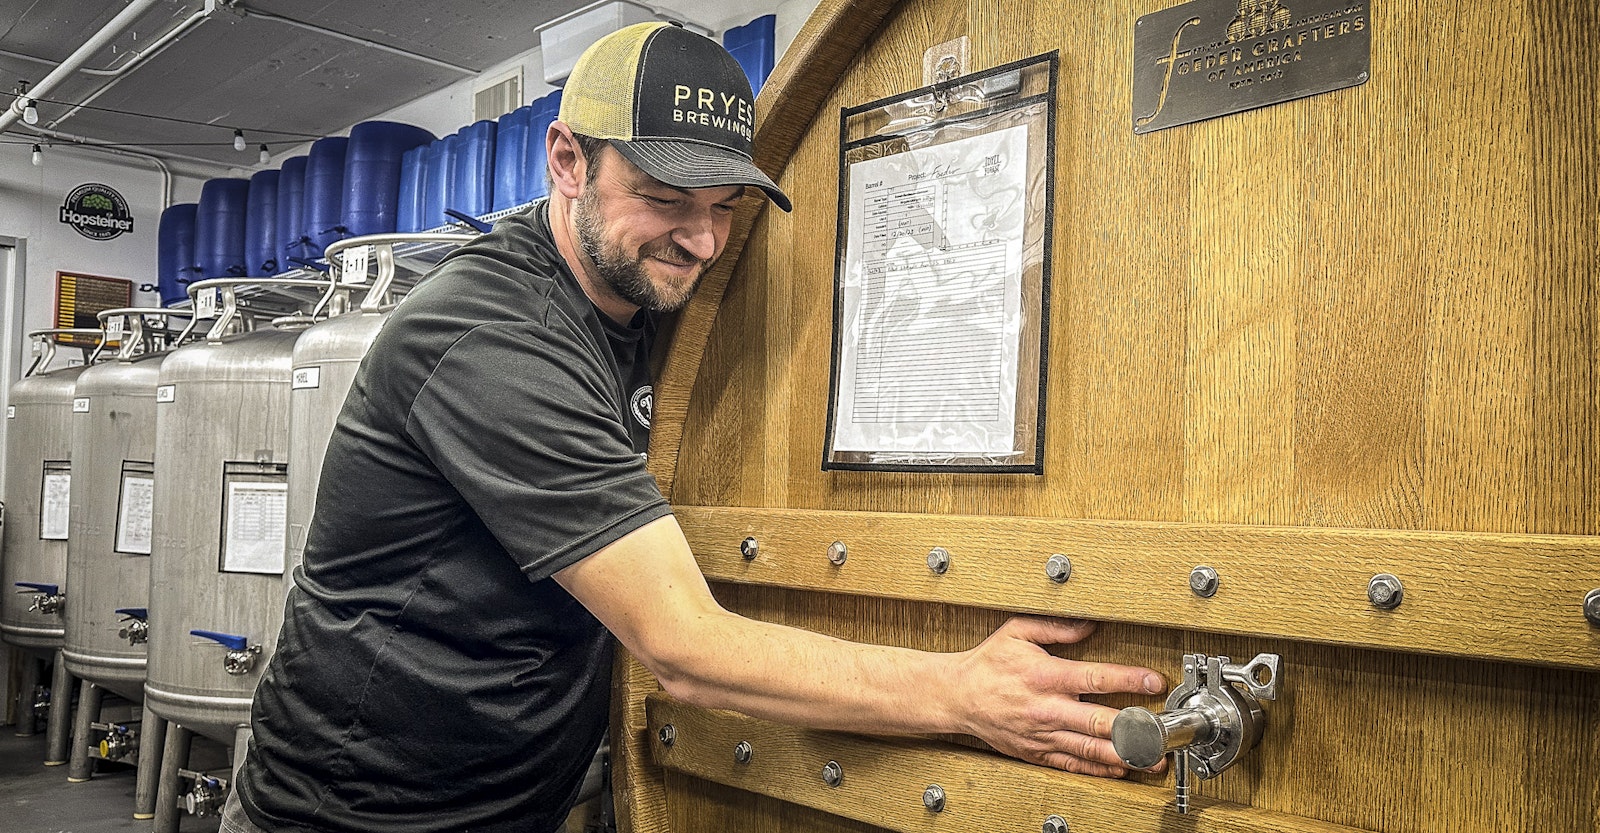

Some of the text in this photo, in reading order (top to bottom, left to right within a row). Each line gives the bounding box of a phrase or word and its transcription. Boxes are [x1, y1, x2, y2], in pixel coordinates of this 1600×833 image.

[1252, 16, 1365, 57] CRAFTERS
[1207, 51, 1302, 83] OF AMERICA
[674, 84, 752, 127] PRYES
[673, 109, 746, 137] BREWING
[62, 209, 132, 231] Hopsteiner
